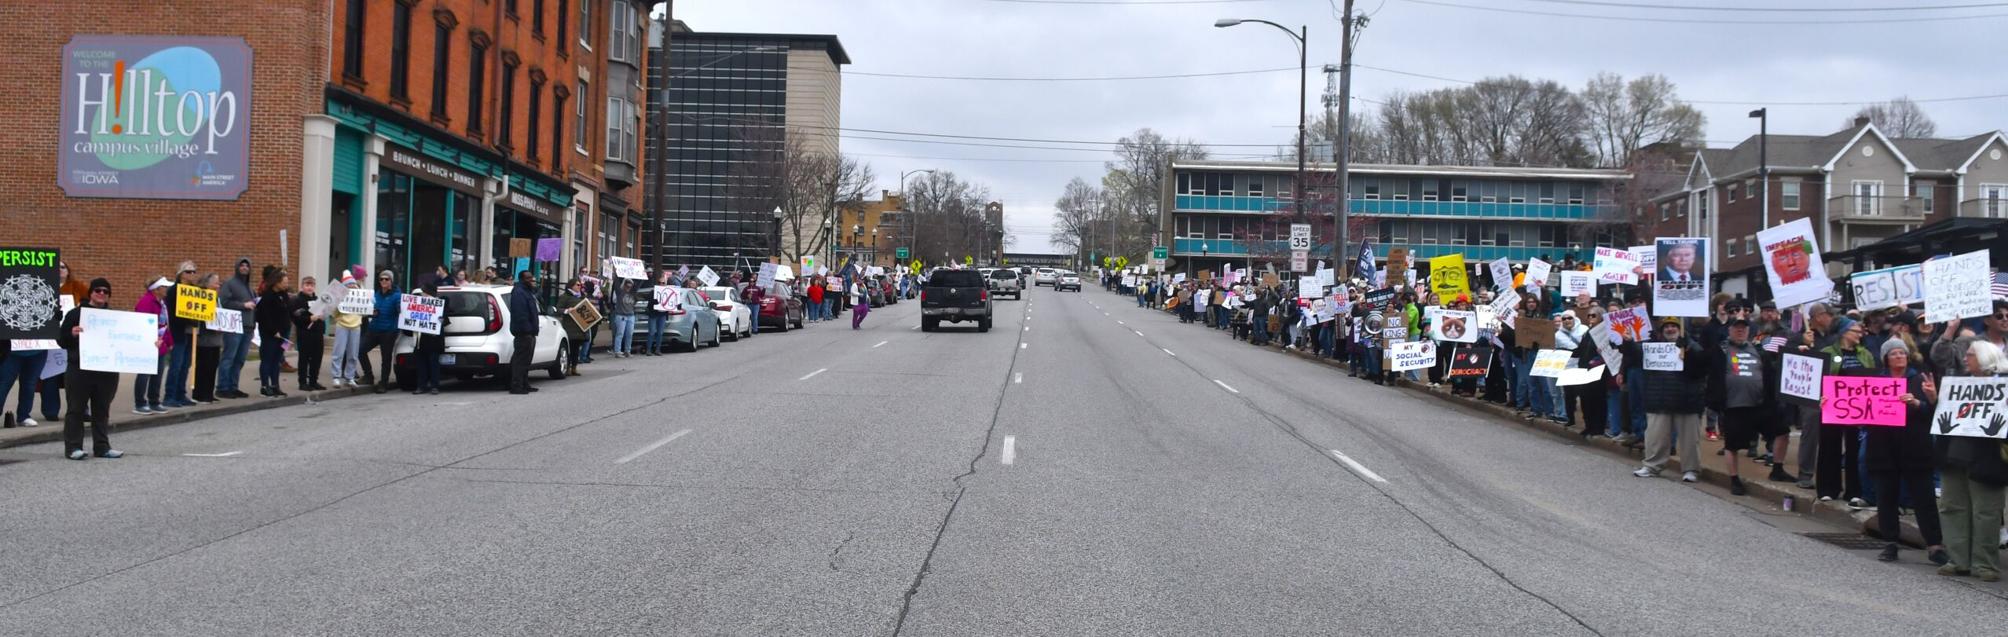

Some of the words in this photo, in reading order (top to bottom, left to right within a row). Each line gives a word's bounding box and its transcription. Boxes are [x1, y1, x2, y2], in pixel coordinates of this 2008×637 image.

[94, 60, 109, 68] THE
[74, 141, 140, 156] campus
[145, 140, 199, 158] village
[393, 151, 420, 169] BRUNCH
[426, 164, 448, 178] LUNCH
[453, 172, 475, 188] DINNER
[82, 175, 119, 184] IOWA
[1293, 238, 1308, 248] 35
[1765, 235, 1804, 252] IMPEACH
[1935, 256, 1985, 273] HANDS
[180, 287, 213, 302] HANDS
[1855, 271, 1922, 306] RESIST
[186, 301, 207, 313] OFF
[403, 295, 417, 304] LOVE
[420, 297, 443, 307] MAKES
[407, 303, 436, 315] AMERICA
[410, 311, 433, 321] GREAT
[577, 304, 597, 325] 8647
[404, 318, 417, 327] NOT
[419, 320, 437, 331] HATE
[1388, 318, 1402, 327] NO
[1384, 328, 1408, 338] KINGS
[1396, 352, 1423, 360] SOCIAL
[1400, 357, 1435, 367] SECURITY
[1456, 353, 1467, 361] MY
[1645, 358, 1677, 369] Democracy
[1787, 357, 1798, 370] We
[1800, 359, 1814, 373] the
[1790, 370, 1812, 385] People
[1785, 377, 1811, 396] Resist
[1834, 379, 1902, 398] Protect
[1948, 383, 2006, 401] HANDS
[1833, 397, 1874, 420] SSA
[1957, 402, 1995, 419] OFF
